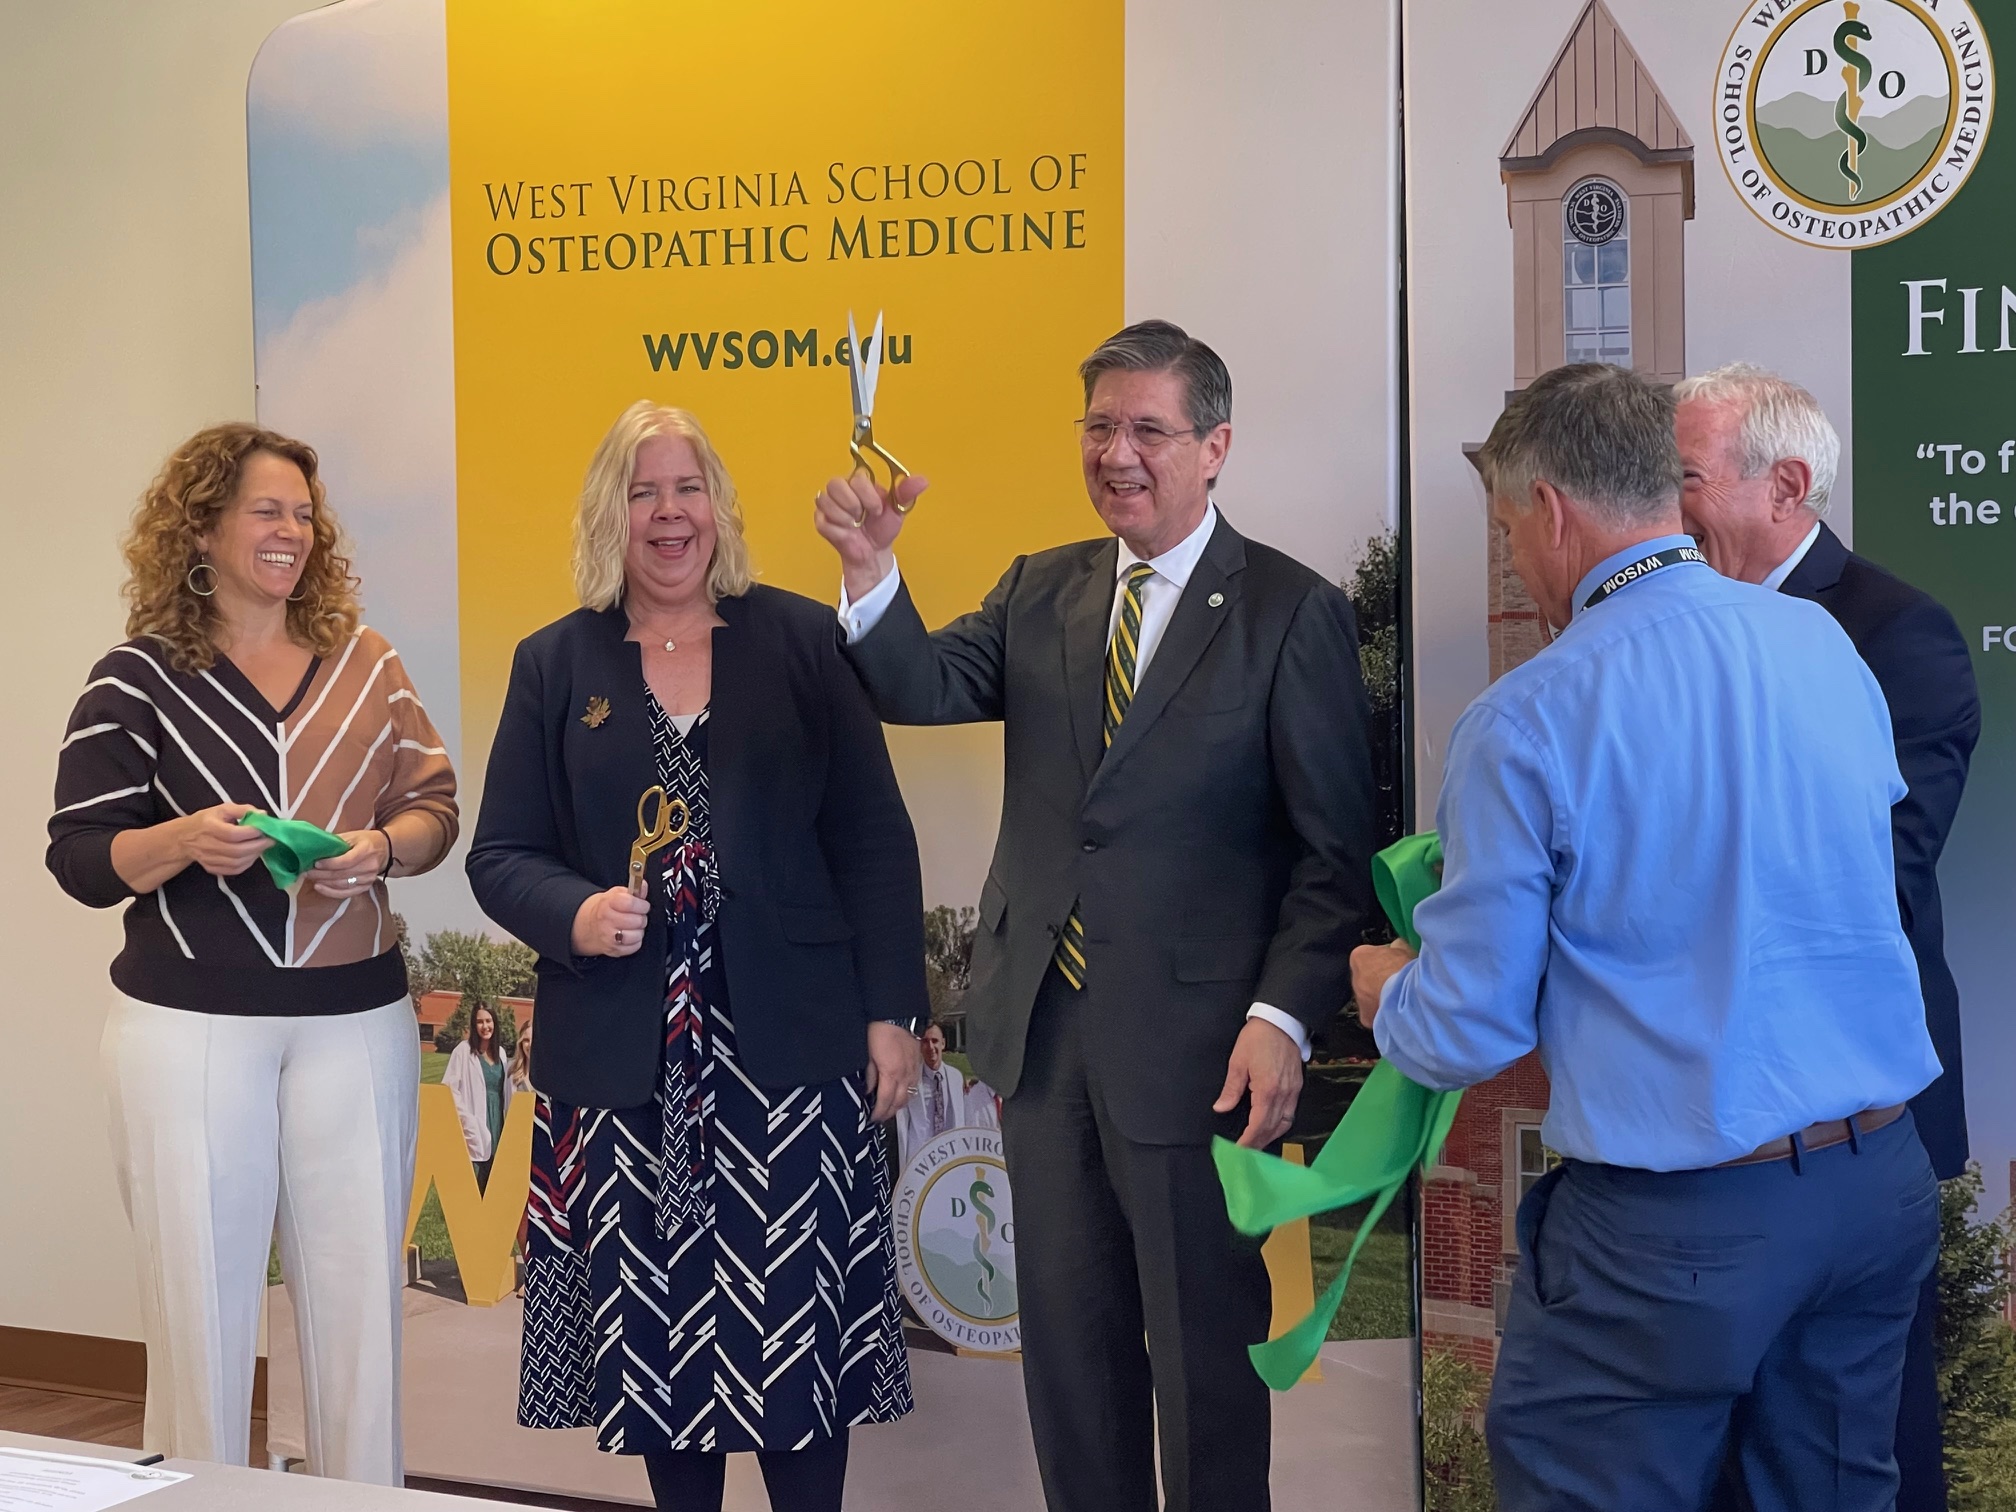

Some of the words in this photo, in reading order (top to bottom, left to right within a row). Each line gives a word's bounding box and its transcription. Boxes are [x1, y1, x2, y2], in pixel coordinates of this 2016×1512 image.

[1752, 0, 1797, 28] WE
[1803, 49, 1828, 76] D
[1878, 70, 1906, 99] O
[1723, 45, 1752, 164] SCHOOL
[1742, 169, 1772, 201] OF
[1771, 173, 1950, 240] OSTEOPATHIC
[1945, 21, 1984, 172] MEDICINE
[483, 182, 593, 222] WEST
[607, 170, 811, 214] VIRGINIA
[826, 158, 1012, 204] SCHOOL
[1029, 153, 1088, 192] OF
[485, 223, 809, 276] OSTEOPATHIC
[826, 209, 1087, 262] MEDICINE
[1929, 492, 2001, 526] the
[1602, 556, 1663, 595] WVSOM
[914, 1140, 957, 1177] WEST
[951, 1197, 967, 1218] D
[897, 1186, 915, 1276] SCHOOL
[910, 1281, 932, 1306] OF
